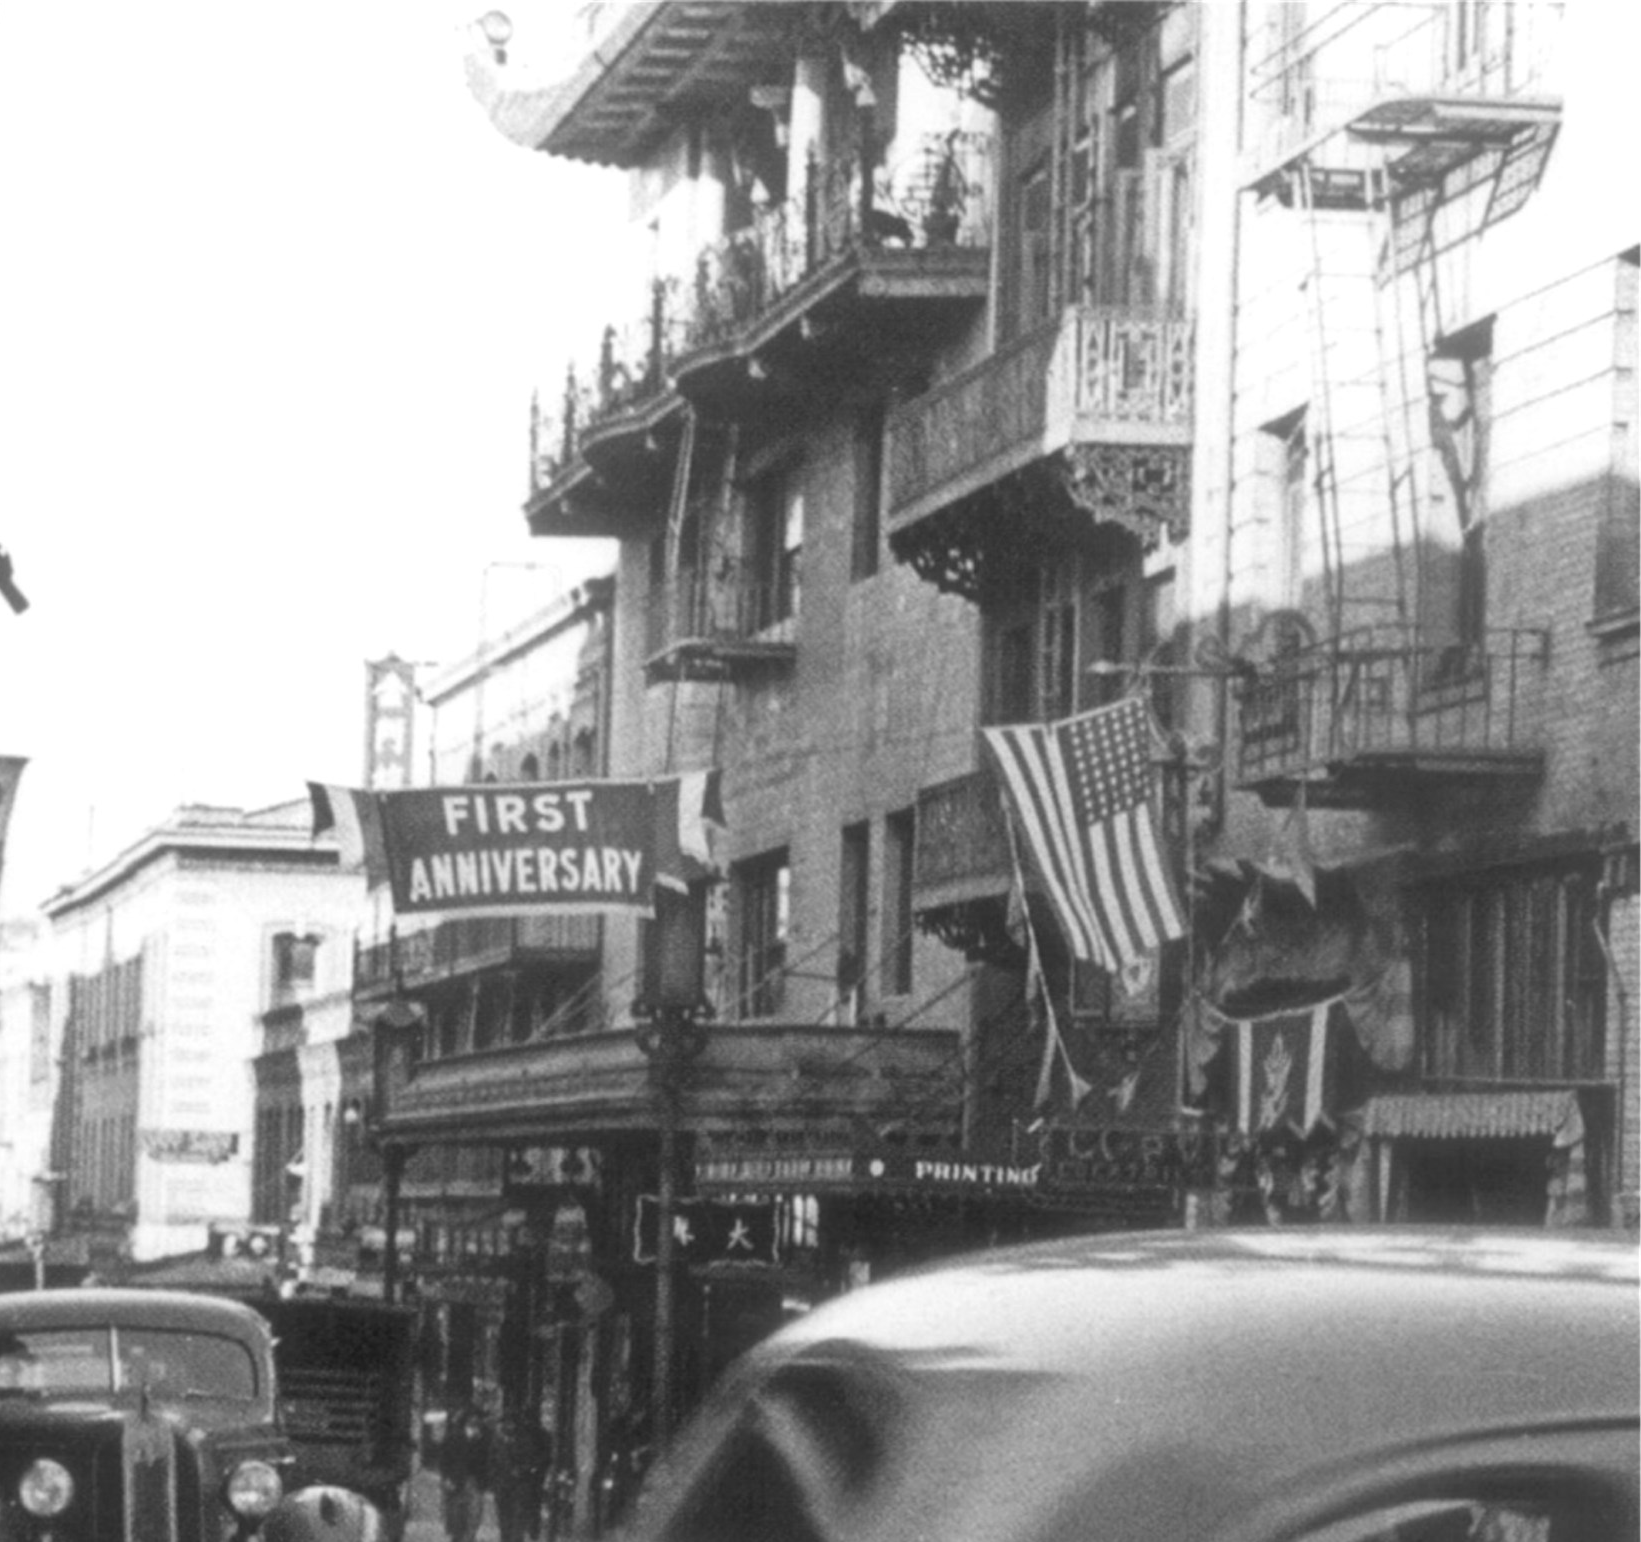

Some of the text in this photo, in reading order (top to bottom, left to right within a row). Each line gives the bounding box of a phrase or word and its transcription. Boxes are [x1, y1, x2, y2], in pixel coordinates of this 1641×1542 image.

[442, 790, 594, 836] FIRST
[409, 848, 643, 902] ANNIVERSARY
[915, 1160, 1040, 1186] PRINTING
